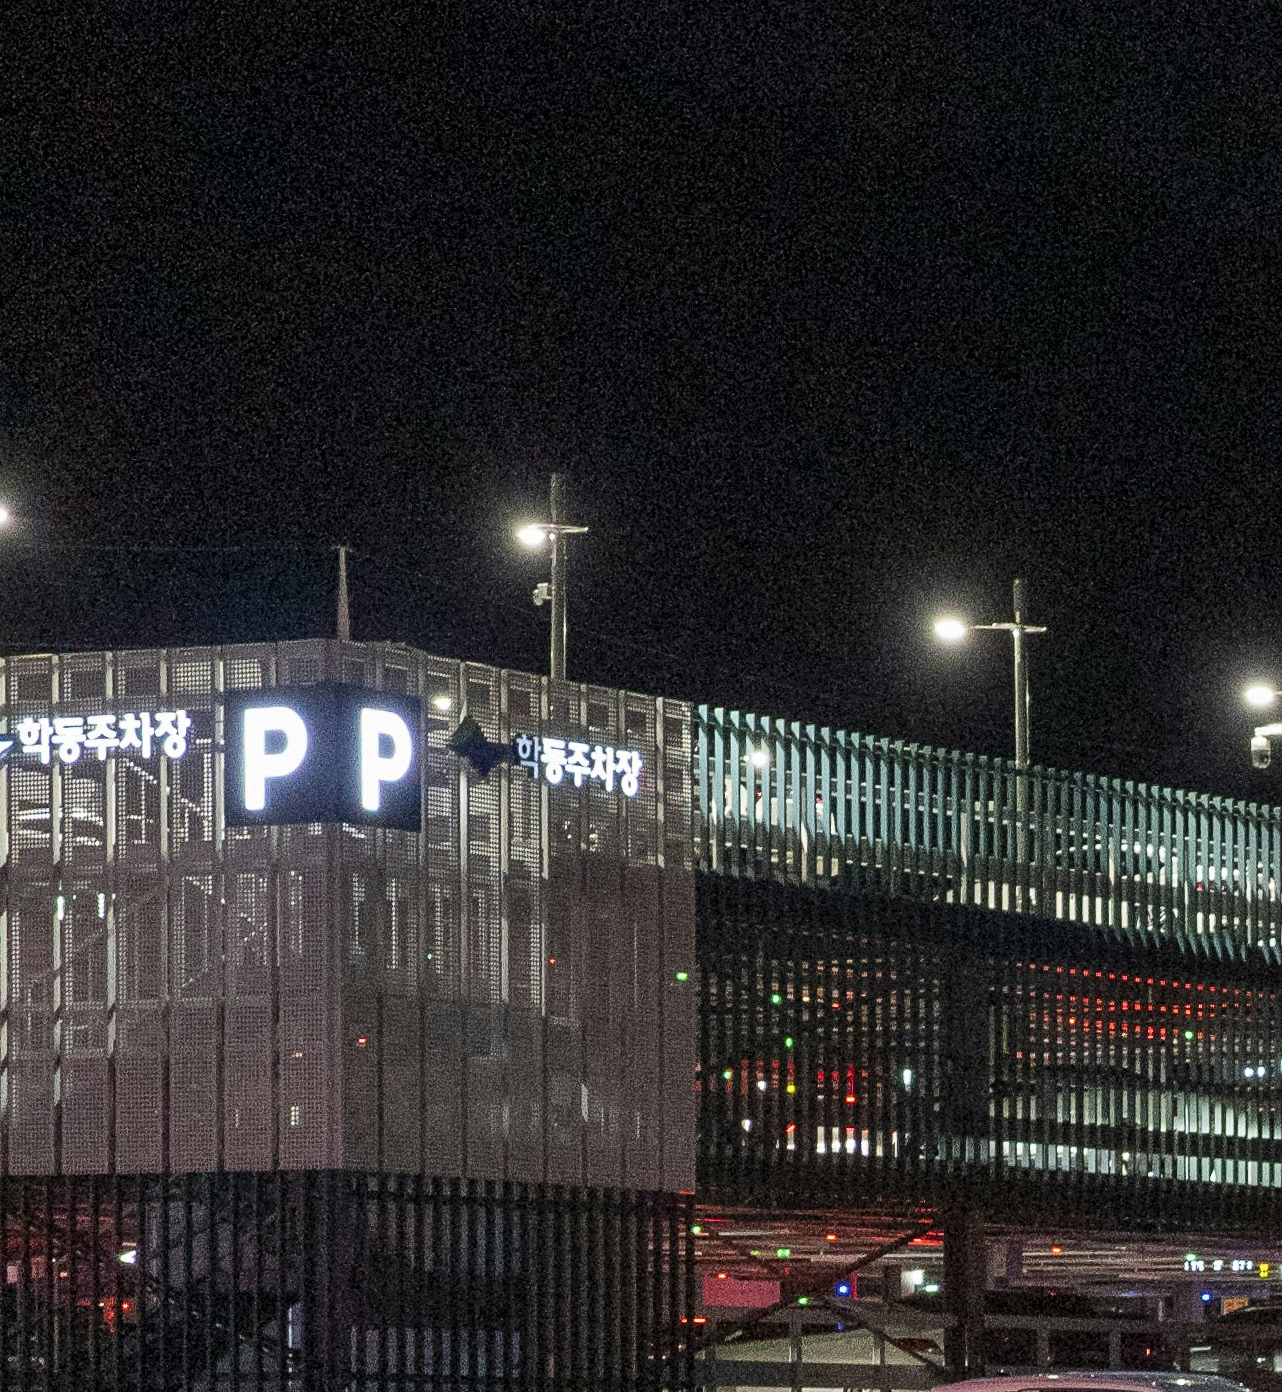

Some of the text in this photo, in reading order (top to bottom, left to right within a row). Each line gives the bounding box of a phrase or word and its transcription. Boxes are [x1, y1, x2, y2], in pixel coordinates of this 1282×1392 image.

[17, 709, 192, 764] 학동주차장
[244, 707, 308, 812] P
[361, 708, 414, 813] P
[516, 734, 643, 797] 학동주차장
